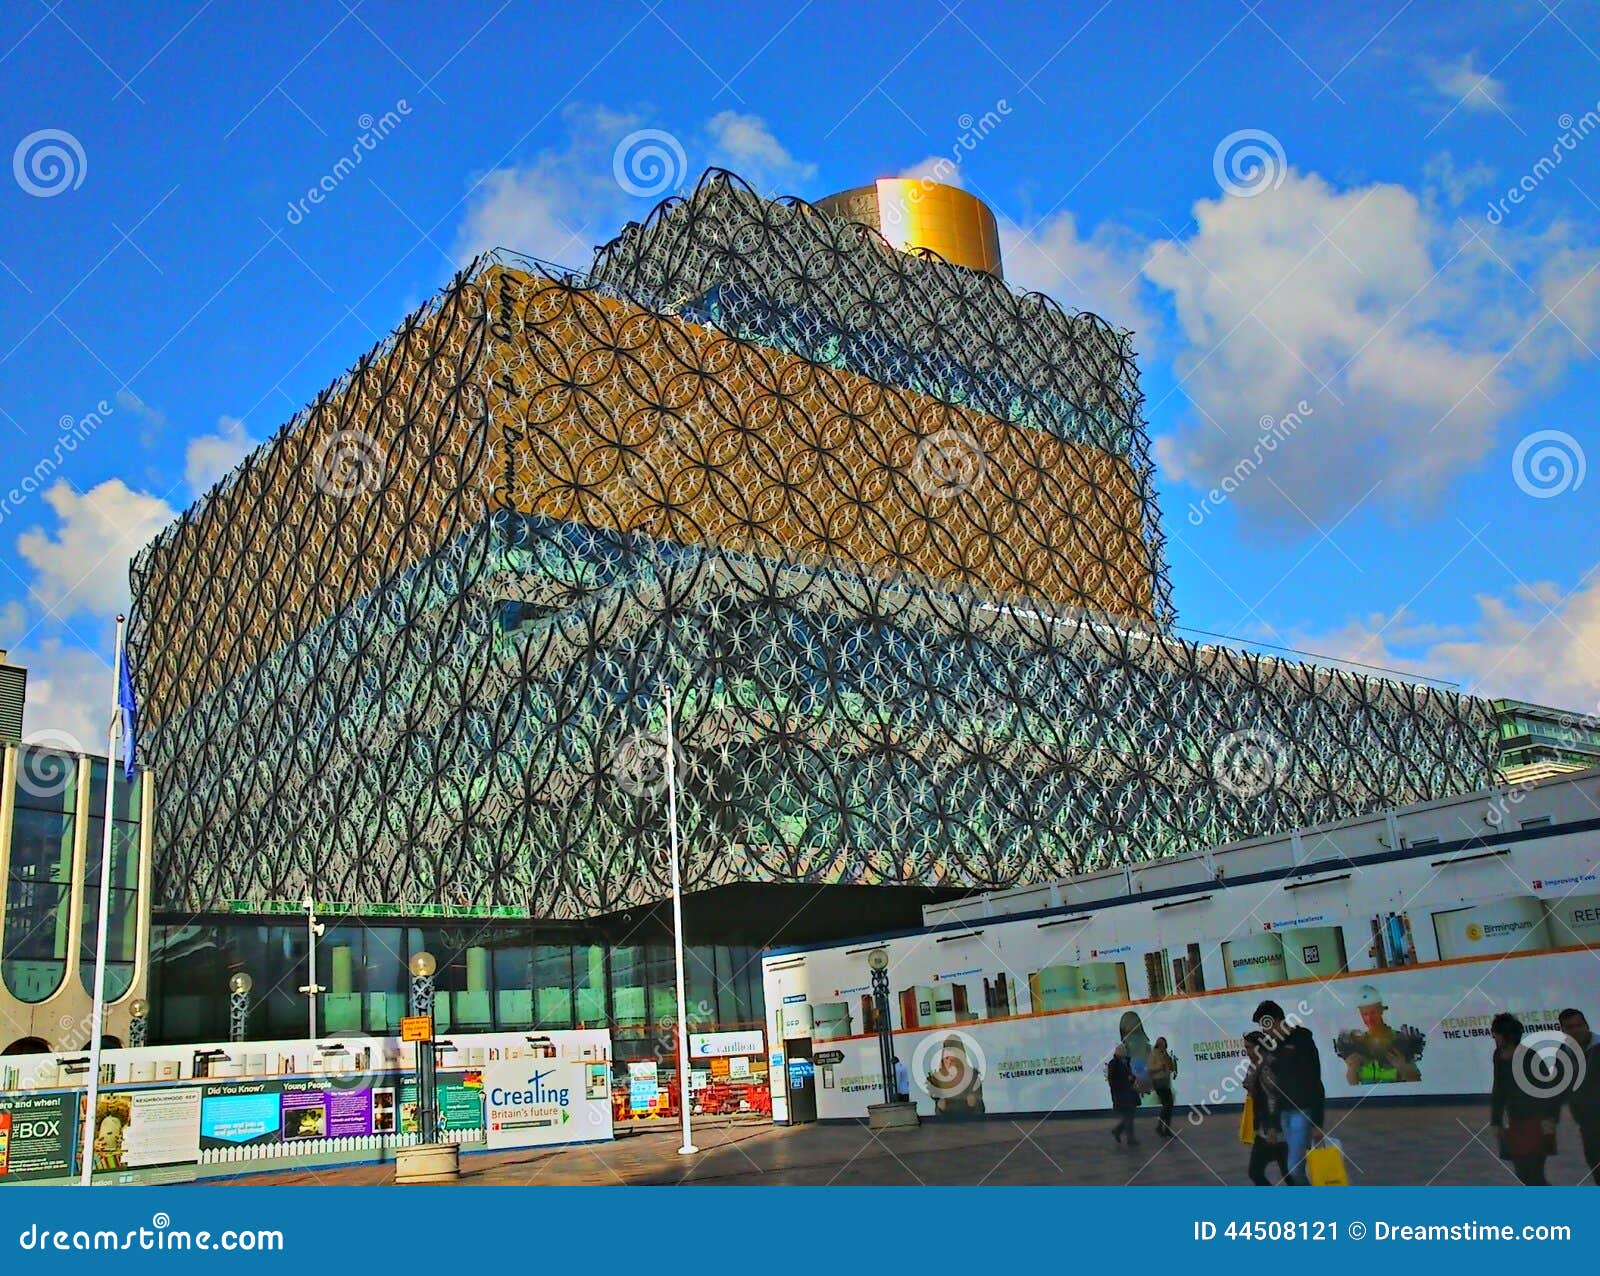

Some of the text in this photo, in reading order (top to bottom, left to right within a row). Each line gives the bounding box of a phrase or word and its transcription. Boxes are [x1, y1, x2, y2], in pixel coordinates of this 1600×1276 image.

[1484, 920, 1532, 934] Birmingham
[1441, 1014, 1491, 1028] REWRITI
[1544, 1009, 1559, 1020] BO
[1443, 1023, 1561, 1039] THE LIBRA IRMING
[1195, 1049, 1247, 1061] THE LIBRARY O
[1011, 1069, 1035, 1078] LIBRARY
[1036, 1067, 1043, 1075] OF
[1045, 1065, 1083, 1075] BIRMINGHAM
[208, 1084, 265, 1095] Did You Know?
[283, 1080, 332, 1091] Young People
[491, 1070, 570, 1106] Creating
[15, 1099, 32, 1108] and
[491, 1109, 528, 1120] Britain's
[531, 1106, 559, 1116] future
[12, 1123, 20, 1139] THE
[20, 1120, 60, 1138] BOX
